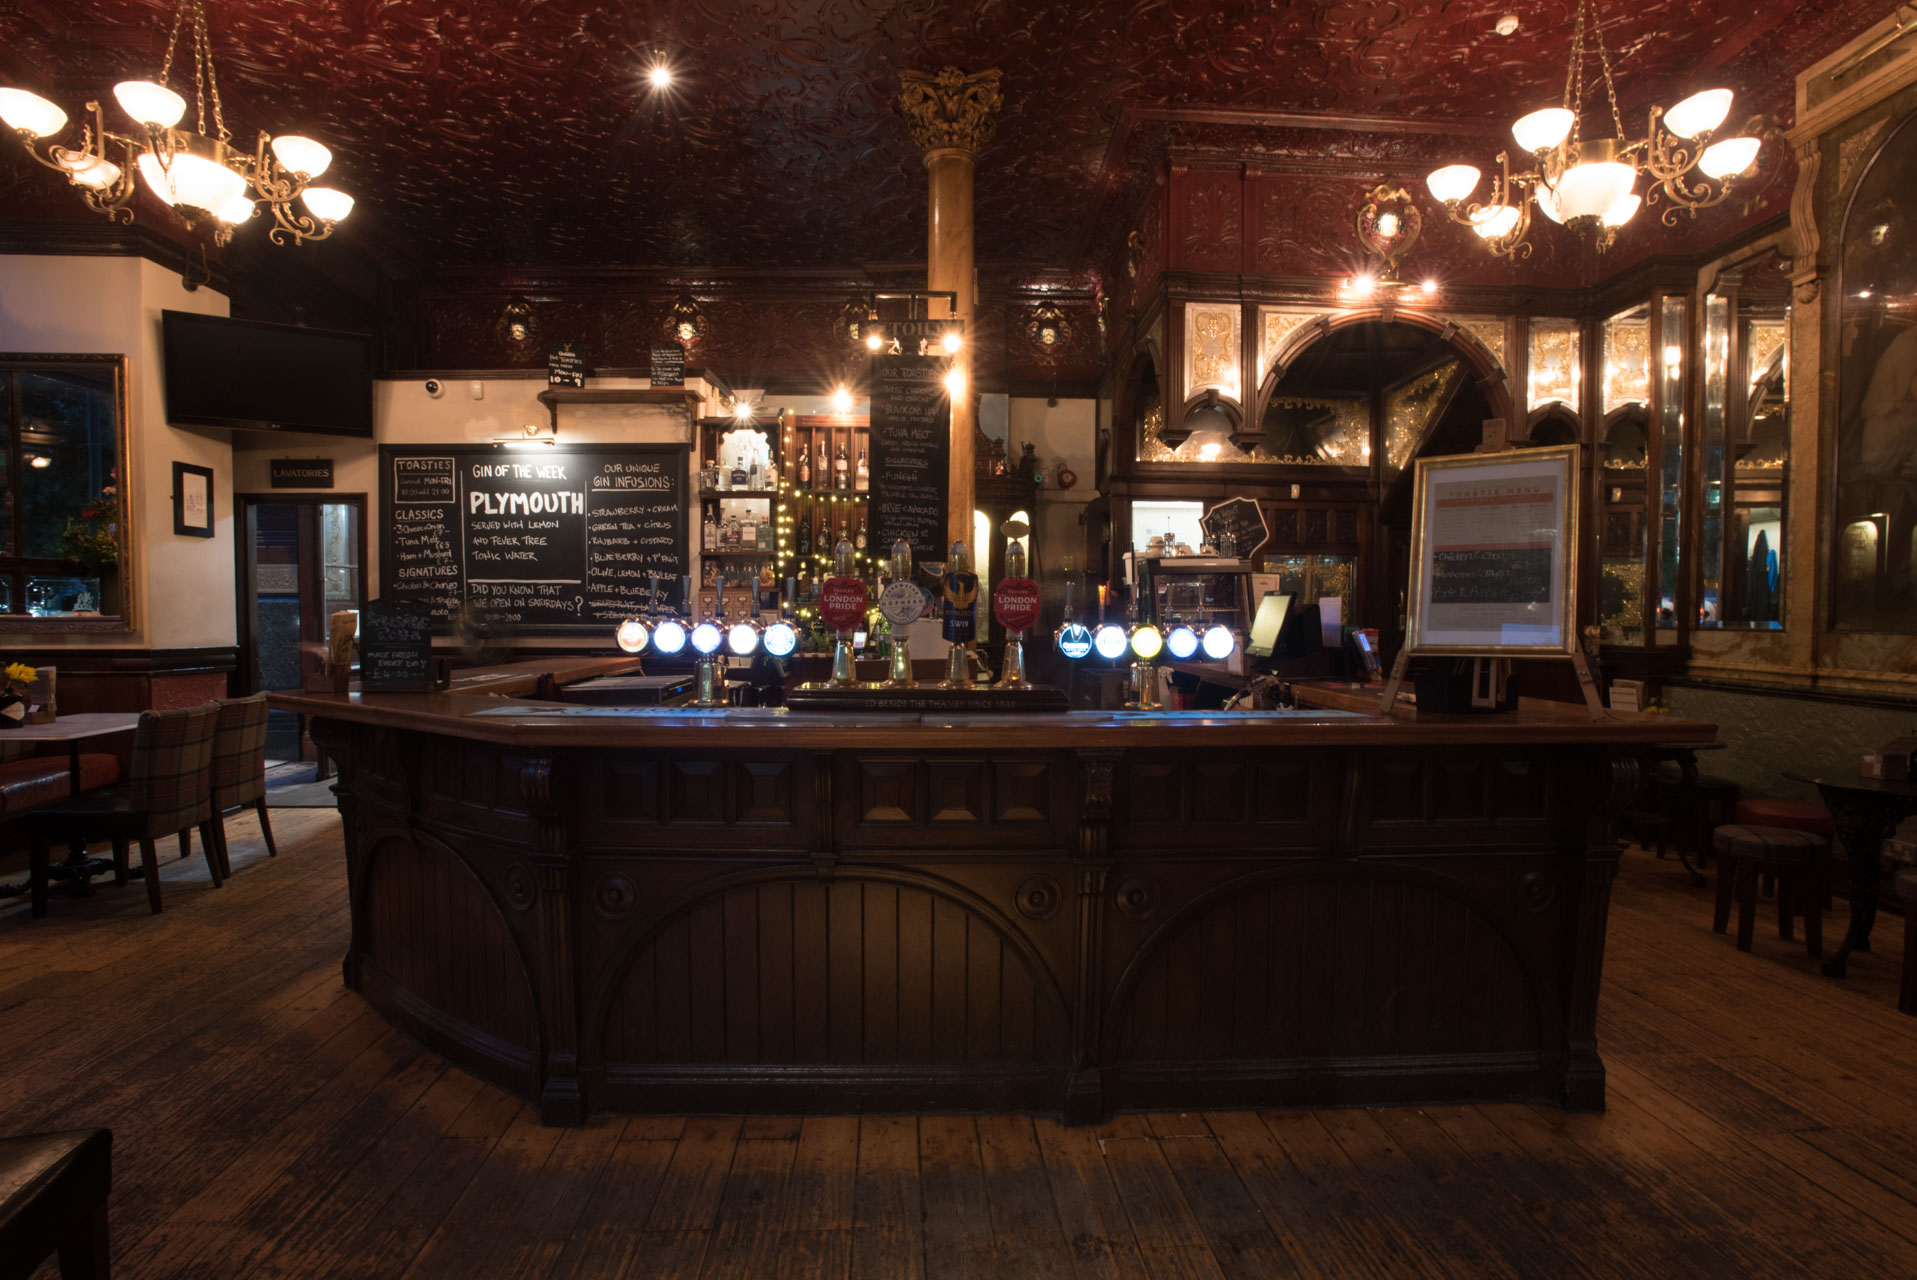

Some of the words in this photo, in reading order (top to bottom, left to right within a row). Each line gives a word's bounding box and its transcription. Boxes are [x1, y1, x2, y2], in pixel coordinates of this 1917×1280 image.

[397, 460, 451, 470] TOASTIES
[604, 464, 623, 474] OUR
[625, 463, 660, 474] UNIQUE
[273, 468, 330, 478] LAVATORIES
[472, 464, 493, 478] GIN
[494, 464, 510, 477] OF
[511, 464, 533, 479] THE
[535, 464, 568, 480] WEEK
[593, 475, 610, 488] GIN
[1449, 489, 1500, 497] TOASTIE
[1507, 487, 1541, 495] MENU
[469, 490, 584, 516] PLYMOUTH
[395, 508, 444, 520] CLASSICS
[591, 506, 645, 517] STRAWBERRY
[652, 504, 678, 513] CREAM
[471, 520, 501, 531] SERVED
[502, 520, 524, 530] WITH
[528, 520, 560, 529] LEMON
[591, 522, 618, 532] GREEN
[619, 522, 635, 530] TEA
[397, 537, 419, 547] Tuna
[472, 536, 489, 546] AND
[489, 535, 520, 546] FEVER
[521, 535, 548, 546] TREE
[591, 537, 630, 546] RHUBARB
[640, 537, 674, 545] CUSTARD
[400, 551, 417, 561] Ham
[472, 550, 501, 561] TONIC
[504, 550, 539, 562] WATER
[398, 565, 458, 578] SIGNATURES
[617, 569, 641, 578] LEMON
[471, 583, 489, 595] DID
[491, 585, 507, 596] YOU
[509, 585, 534, 595] KNOW
[536, 585, 563, 595] THAT
[590, 582, 614, 593] APPLE
[620, 585, 669, 602] BLUEBERY
[473, 598, 488, 608] WE
[490, 597, 511, 608] OPEN
[513, 597, 526, 608] ON
[824, 595, 863, 604] LONDON
[998, 596, 1037, 605] LONDON
[829, 603, 857, 611] PRIDE
[949, 619, 969, 628] SW19
[909, 698, 926, 708] THE
